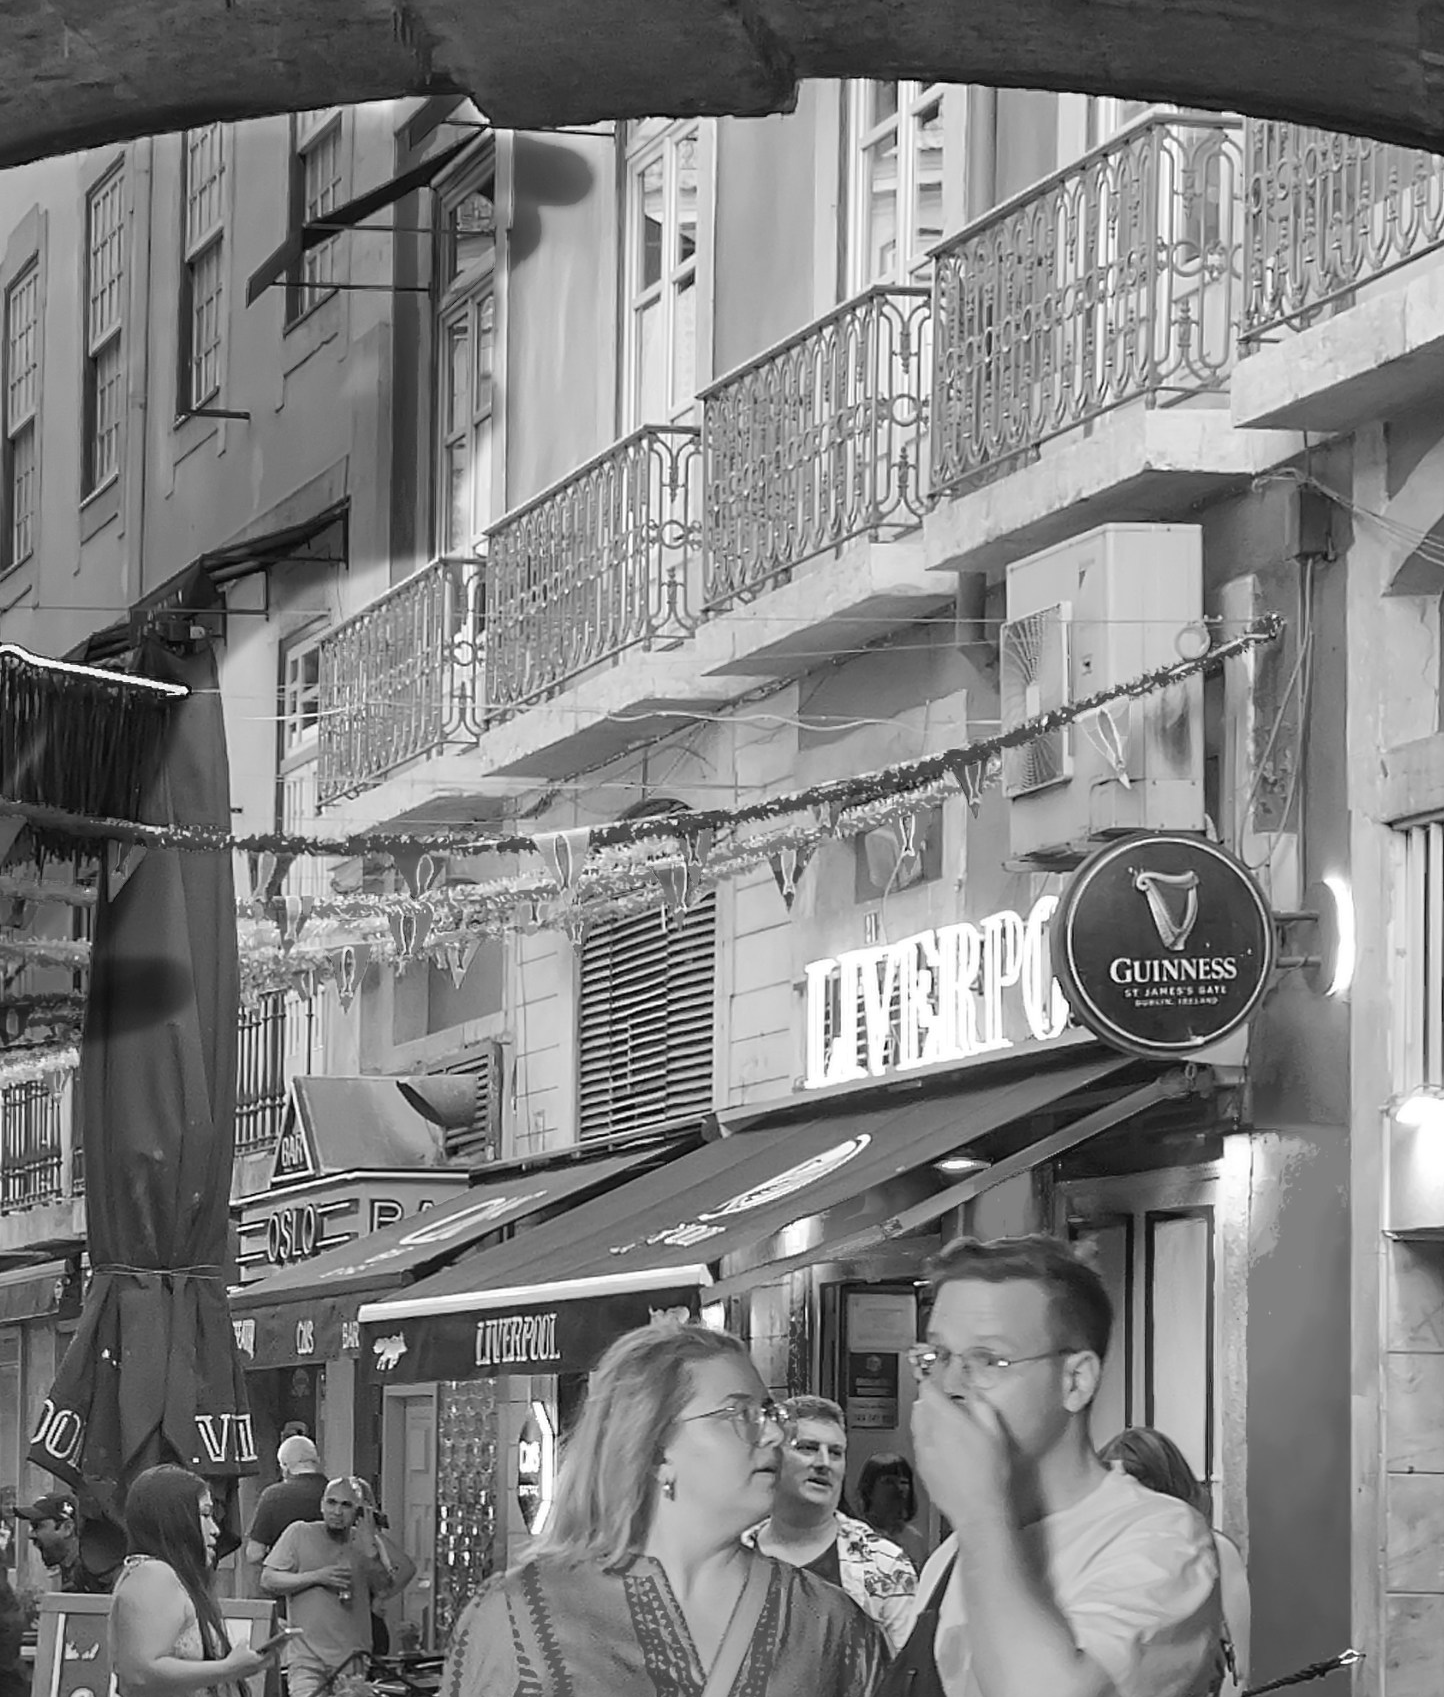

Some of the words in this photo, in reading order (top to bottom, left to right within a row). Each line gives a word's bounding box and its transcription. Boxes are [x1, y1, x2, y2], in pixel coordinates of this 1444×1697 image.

[804, 895, 1070, 1090] LIVERPO
[1109, 957, 1238, 984] GUINNESS
[267, 1204, 318, 1263] OSLO
[475, 1313, 560, 1366] LIVERPOOL
